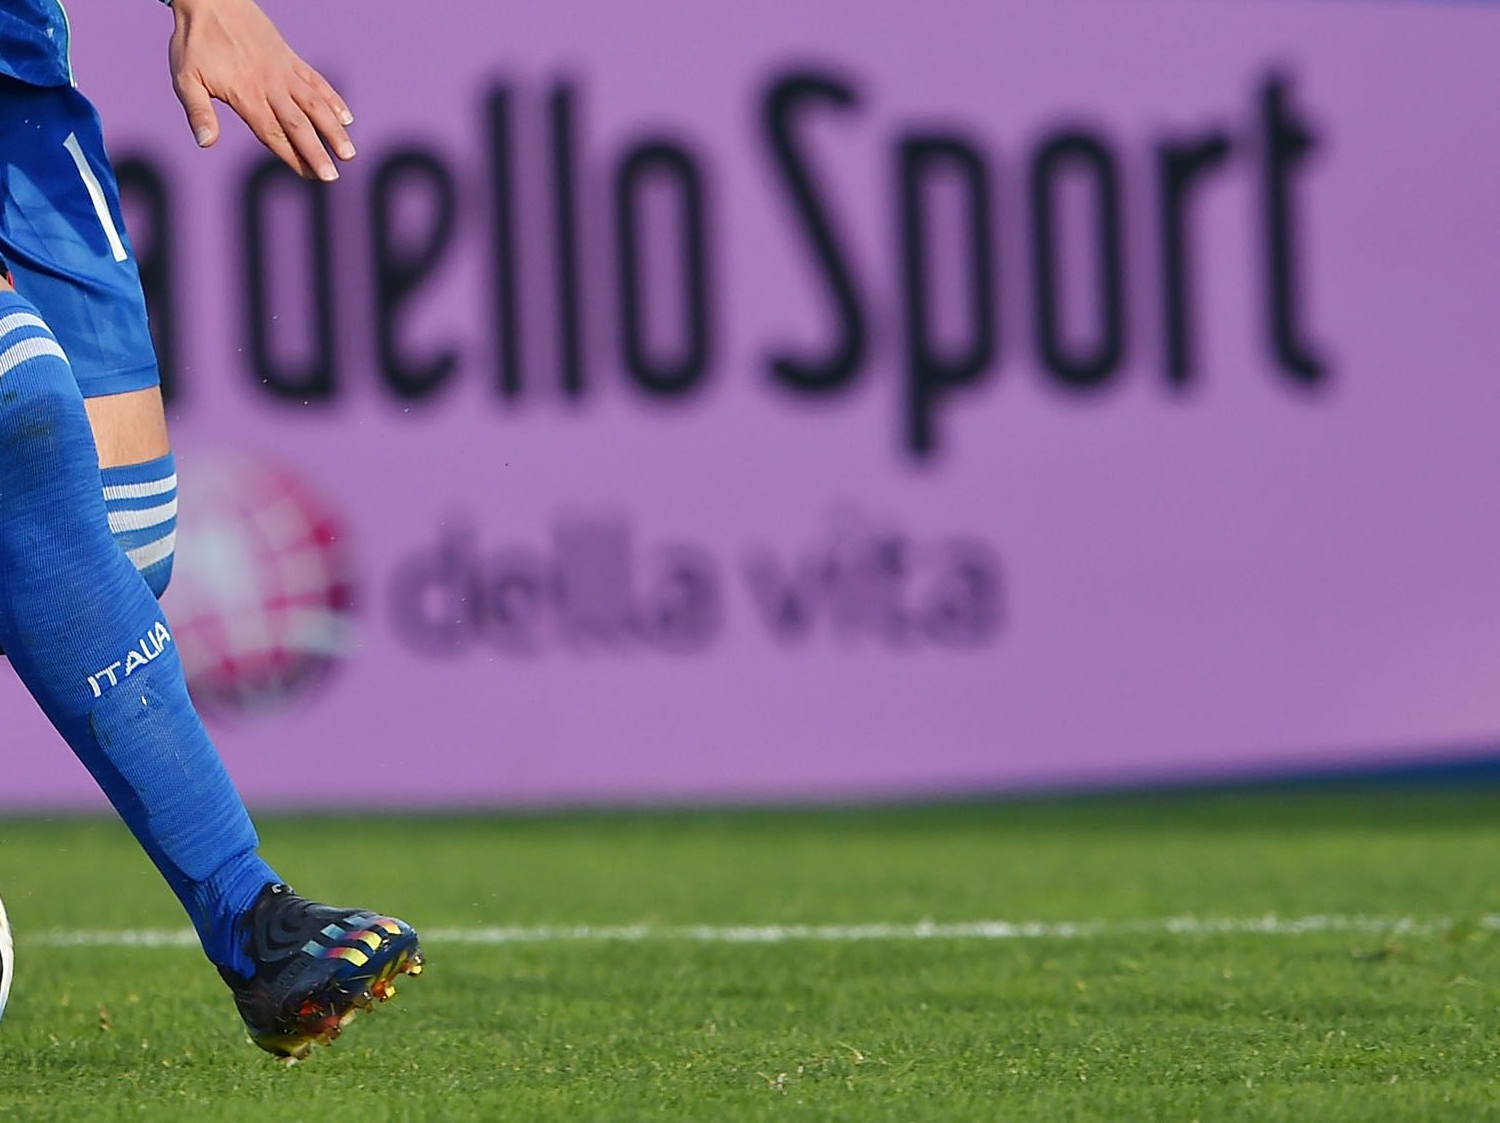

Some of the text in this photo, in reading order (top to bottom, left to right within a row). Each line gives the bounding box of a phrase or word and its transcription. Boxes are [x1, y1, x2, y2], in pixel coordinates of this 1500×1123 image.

[238, 70, 712, 400] dello
[755, 68, 1333, 466] Sport
[87, 621, 171, 698] ITALIA
[388, 508, 722, 660] della
[738, 498, 1008, 653] vita
